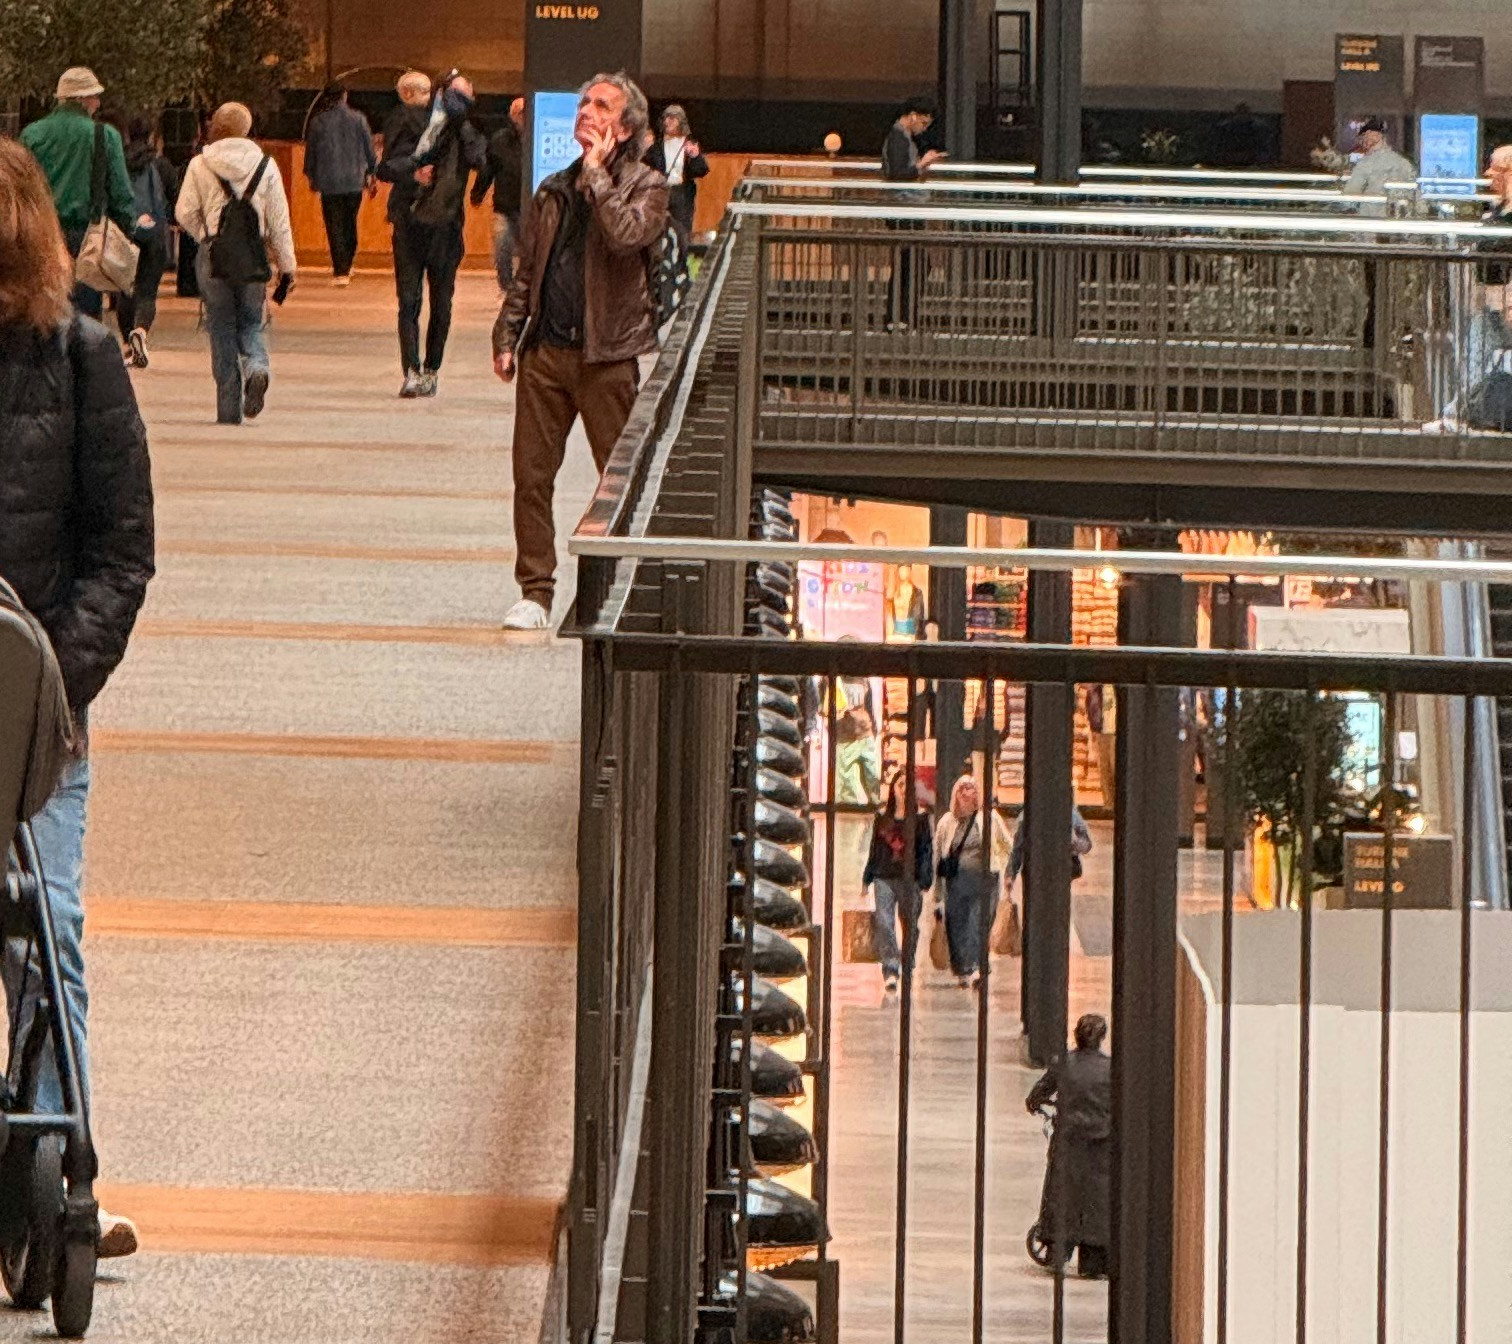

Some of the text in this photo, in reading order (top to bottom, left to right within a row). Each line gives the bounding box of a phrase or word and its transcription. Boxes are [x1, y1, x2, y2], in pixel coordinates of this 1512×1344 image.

[535, 5, 600, 20] LEVEL UG
[1354, 880, 1385, 893] LEVE
